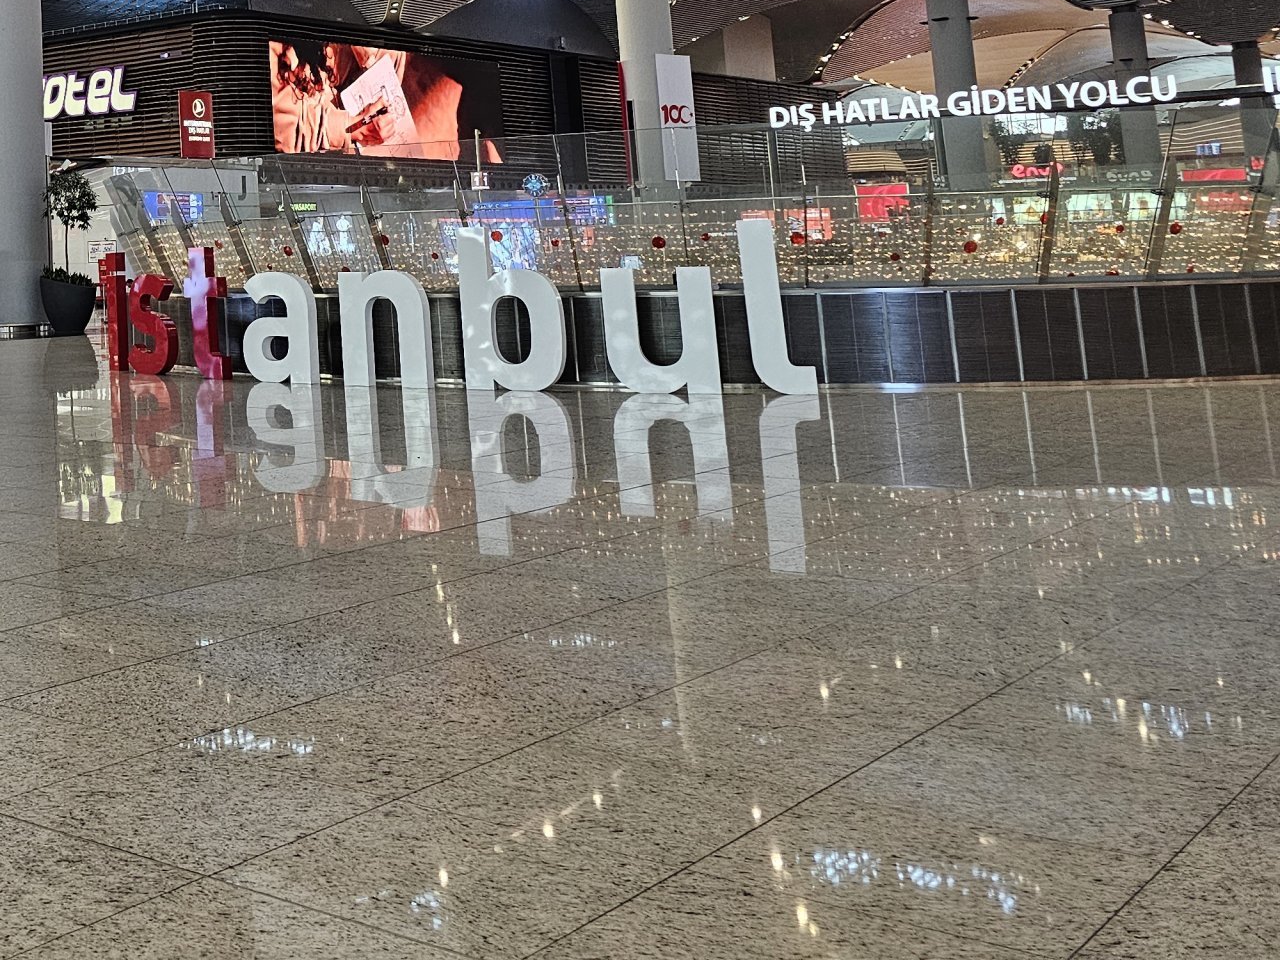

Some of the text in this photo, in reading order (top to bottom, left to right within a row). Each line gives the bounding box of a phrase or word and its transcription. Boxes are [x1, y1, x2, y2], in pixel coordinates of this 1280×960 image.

[769, 75, 1178, 133] DIŞ HATLAR GİDEN YOLCU
[238, 175, 247, 200] J
